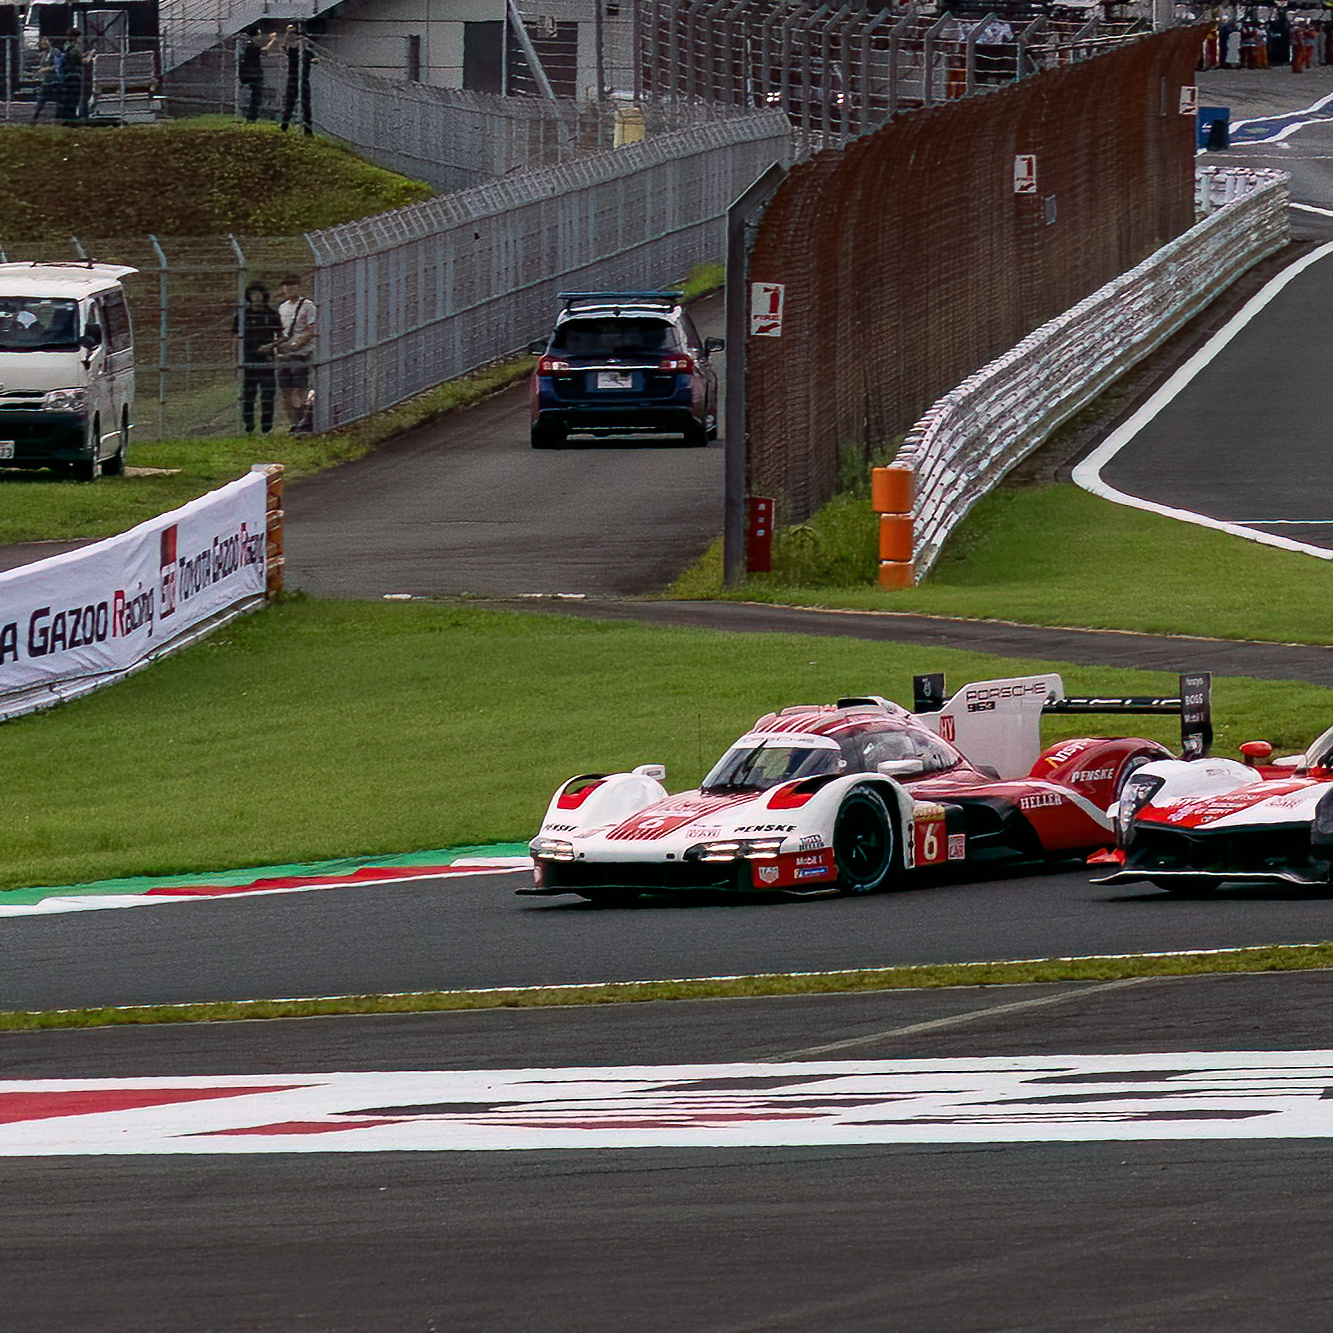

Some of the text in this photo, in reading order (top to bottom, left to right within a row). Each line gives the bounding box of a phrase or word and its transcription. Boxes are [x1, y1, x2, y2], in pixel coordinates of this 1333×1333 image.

[28, 600, 108, 658] GAZOO
[112, 581, 154, 639] Racing
[966, 682, 1046, 702] PORSCHE
[967, 701, 995, 712] 963
[1071, 767, 1115, 784] PENSKE
[1020, 793, 1063, 810] HELLER
[638, 817, 665, 829] 6
[734, 824, 798, 834] PENSKE
[924, 823, 938, 861] 6
